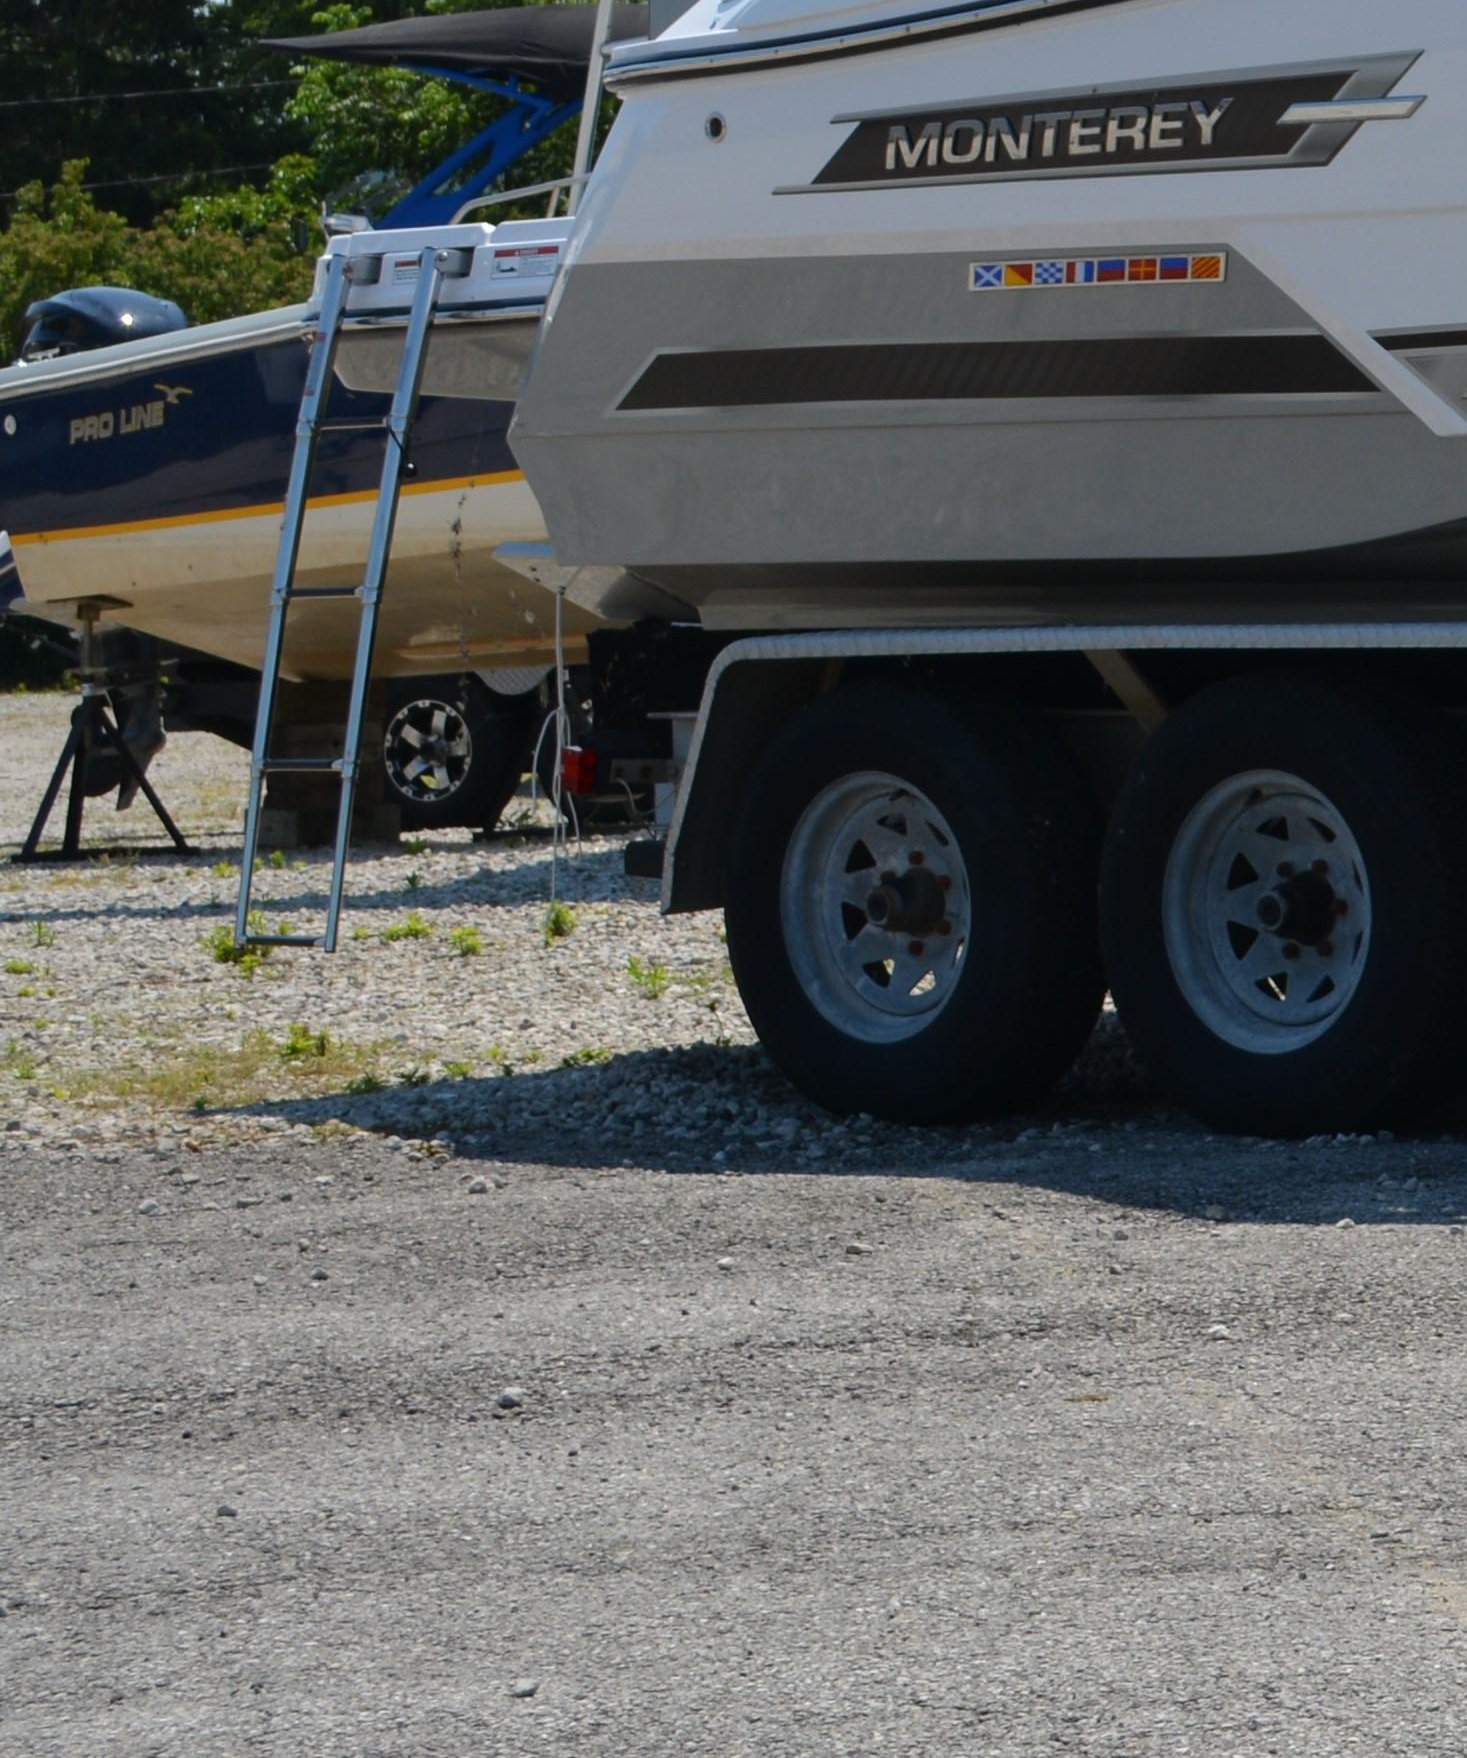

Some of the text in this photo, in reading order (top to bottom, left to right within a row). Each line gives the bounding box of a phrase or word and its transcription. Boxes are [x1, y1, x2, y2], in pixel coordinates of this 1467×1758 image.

[884, 97, 1235, 170] MONTEREY
[70, 400, 165, 445] PRO LINE
